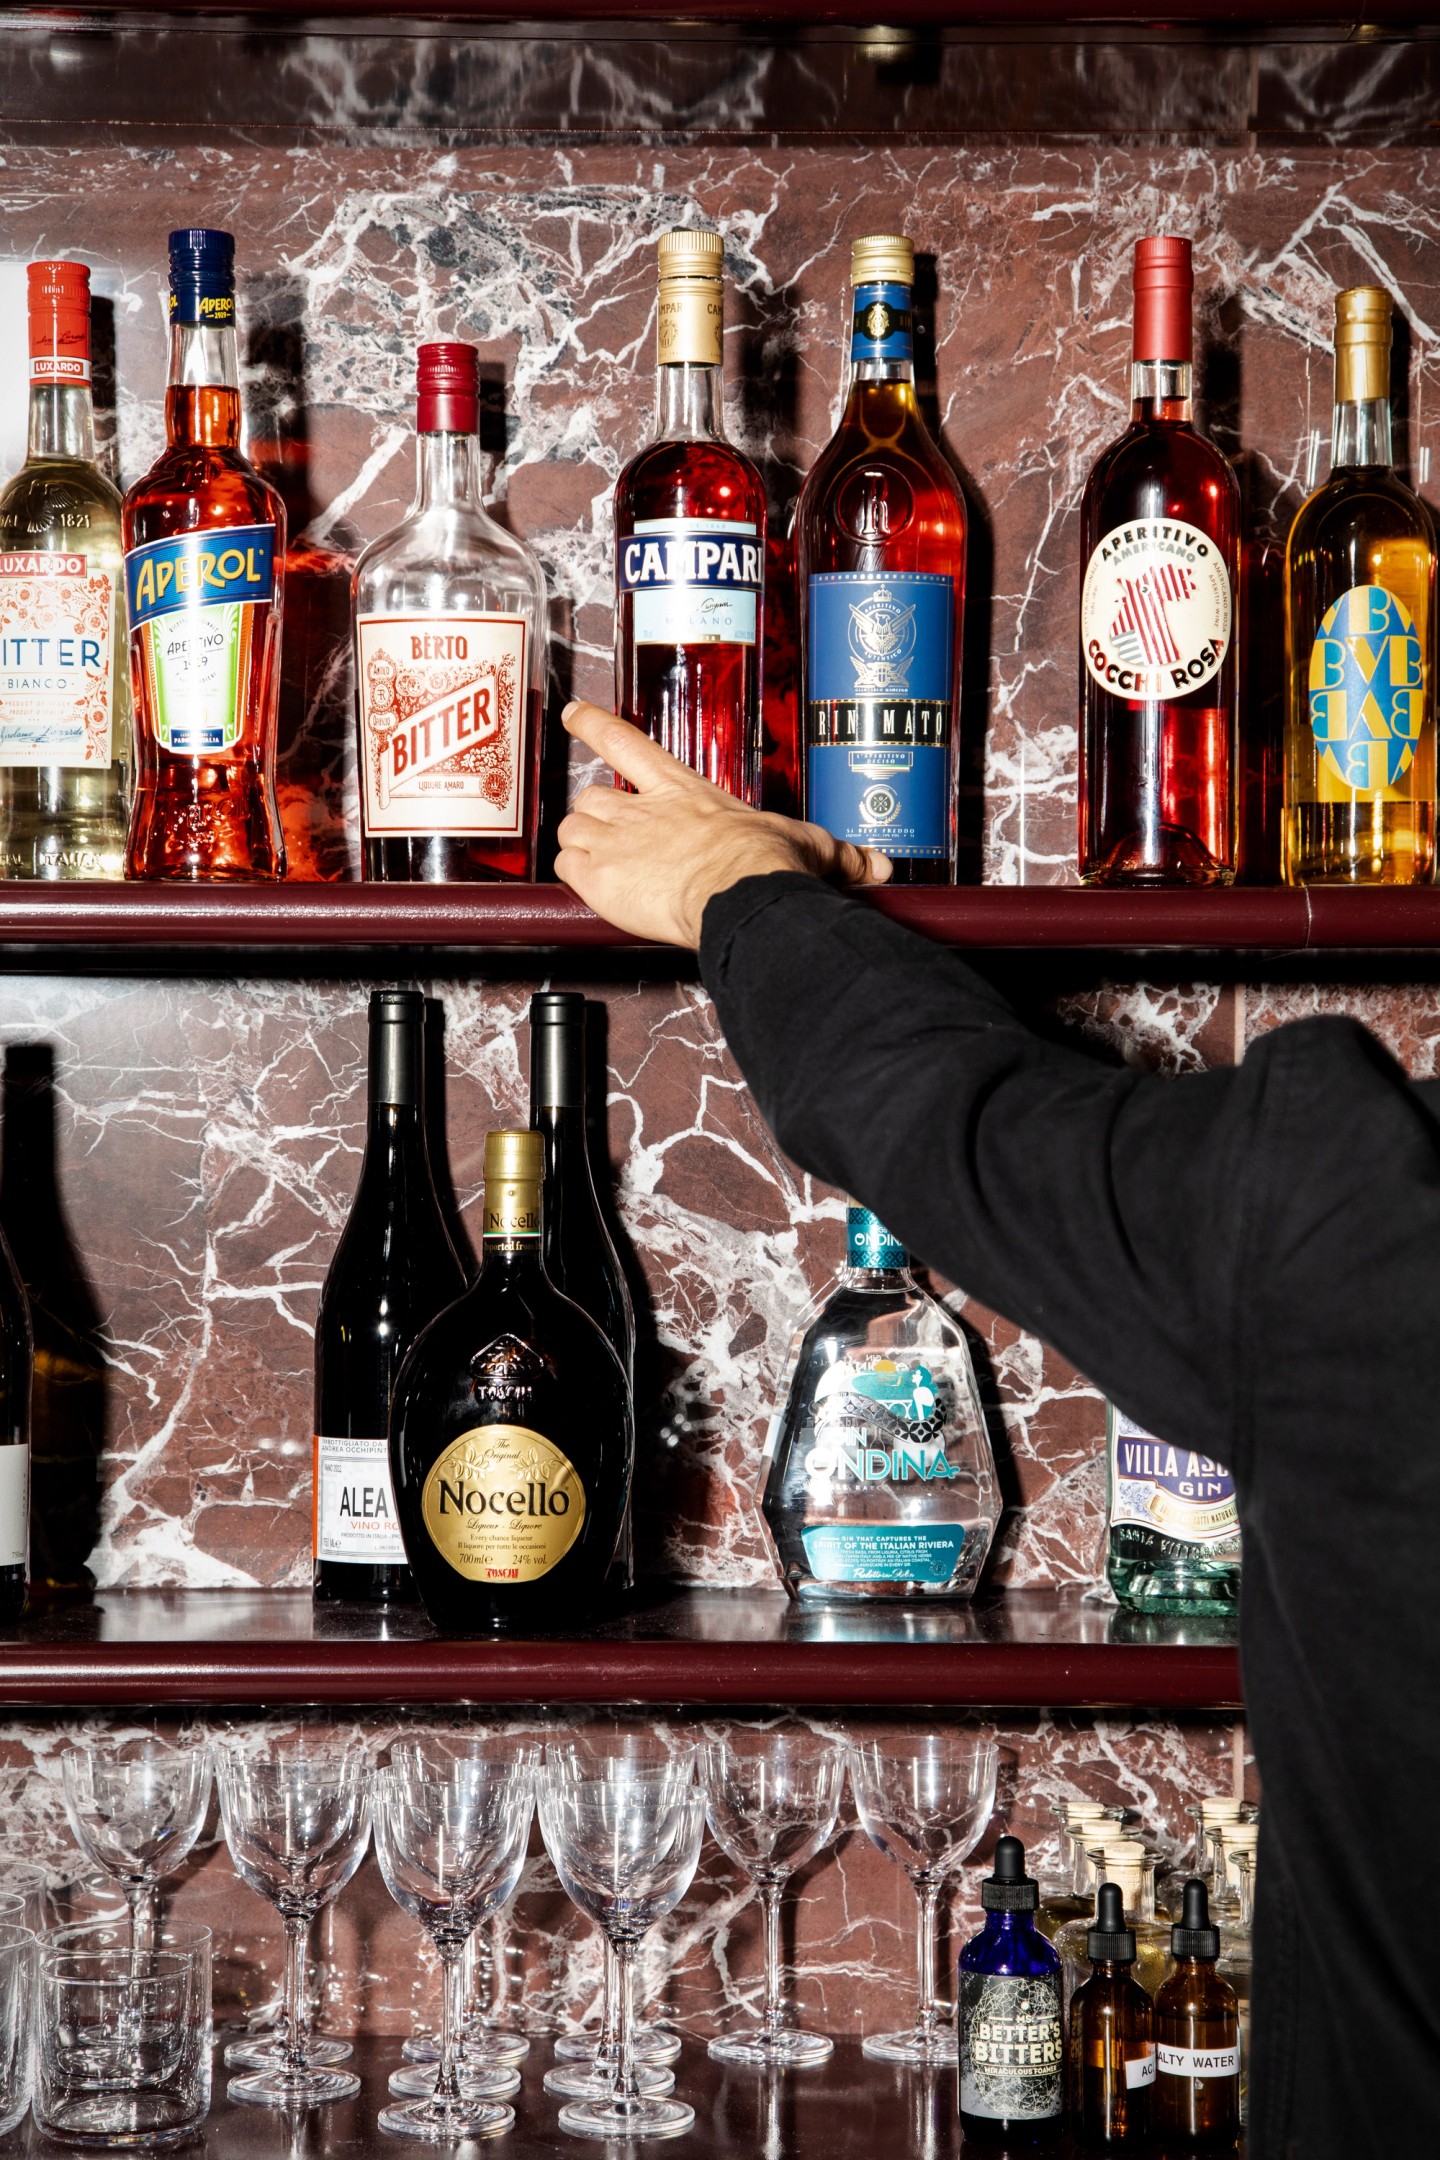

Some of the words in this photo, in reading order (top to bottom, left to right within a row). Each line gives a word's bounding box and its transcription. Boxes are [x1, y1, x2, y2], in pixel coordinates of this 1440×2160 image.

[35, 362, 81, 372] LUXARDO
[61, 513, 90, 528] 1821
[1101, 525, 1209, 561] APERITIVO
[1113, 542, 1195, 566] AMERICANO
[0, 557, 82, 573] UXARDO
[136, 548, 261, 611] APEROL
[1213, 562, 1228, 608] AMERICANO
[1209, 574, 1220, 605] APERITIF
[666, 617, 732, 625] MLANO
[3, 639, 100, 667] ITTER
[1088, 639, 1162, 693] COCCHI
[1170, 638, 1224, 688] ROSA
[8, 679, 67, 689] BIANCO
[818, 709, 943, 735] RINMATO
[392, 688, 491, 776] BITTER
[322, 1439, 369, 1447] IMBOTTIGLIATO
[493, 1438, 509, 1448] The
[483, 1449, 520, 1463] Original
[1124, 1443, 1178, 1477] VILLA
[805, 1448, 958, 1481] ONDINA
[437, 1479, 569, 1516] Nocello
[1179, 1482, 1221, 1497] GIN
[340, 1487, 388, 1518] ALEA
[351, 1521, 380, 1530] VINO
[466, 1518, 499, 1532] Liqueur
[509, 1519, 542, 1532] Liquore
[464, 1542, 483, 1550] liquore
[919, 1541, 954, 1549] RIVIERA
[513, 1555, 531, 1565] 24%
[1016, 2015, 1035, 2023] MS.
[980, 2021, 1060, 2042] BETTER'S
[975, 2039, 1062, 2064] BITTERS
[1158, 2051, 1184, 2066] ALTY
[1193, 2056, 1234, 2068] WATER
[984, 2066, 1033, 2075] MIRACULOUS
